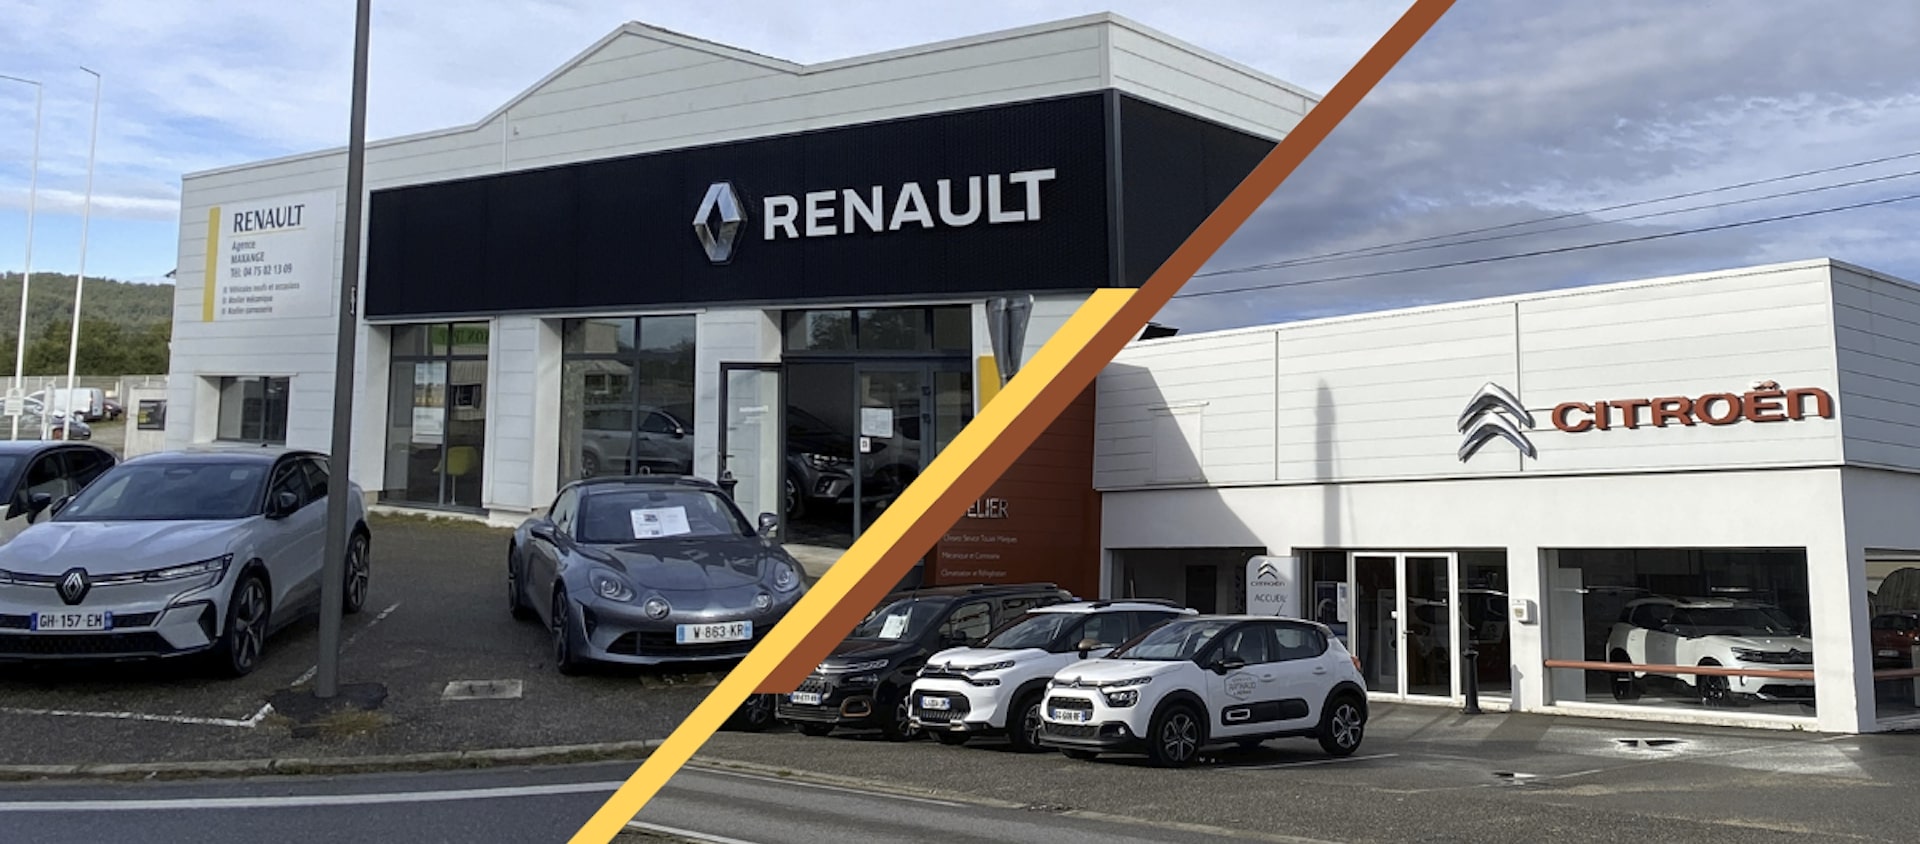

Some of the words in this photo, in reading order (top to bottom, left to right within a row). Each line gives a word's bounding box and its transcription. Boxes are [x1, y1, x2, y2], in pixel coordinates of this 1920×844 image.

[763, 168, 1056, 240] RENAULT
[233, 204, 305, 233] RENAULT
[231, 241, 256, 252] Agence
[243, 267, 252, 277] 04
[254, 265, 262, 276] 75
[967, 498, 1009, 518] ELIER
